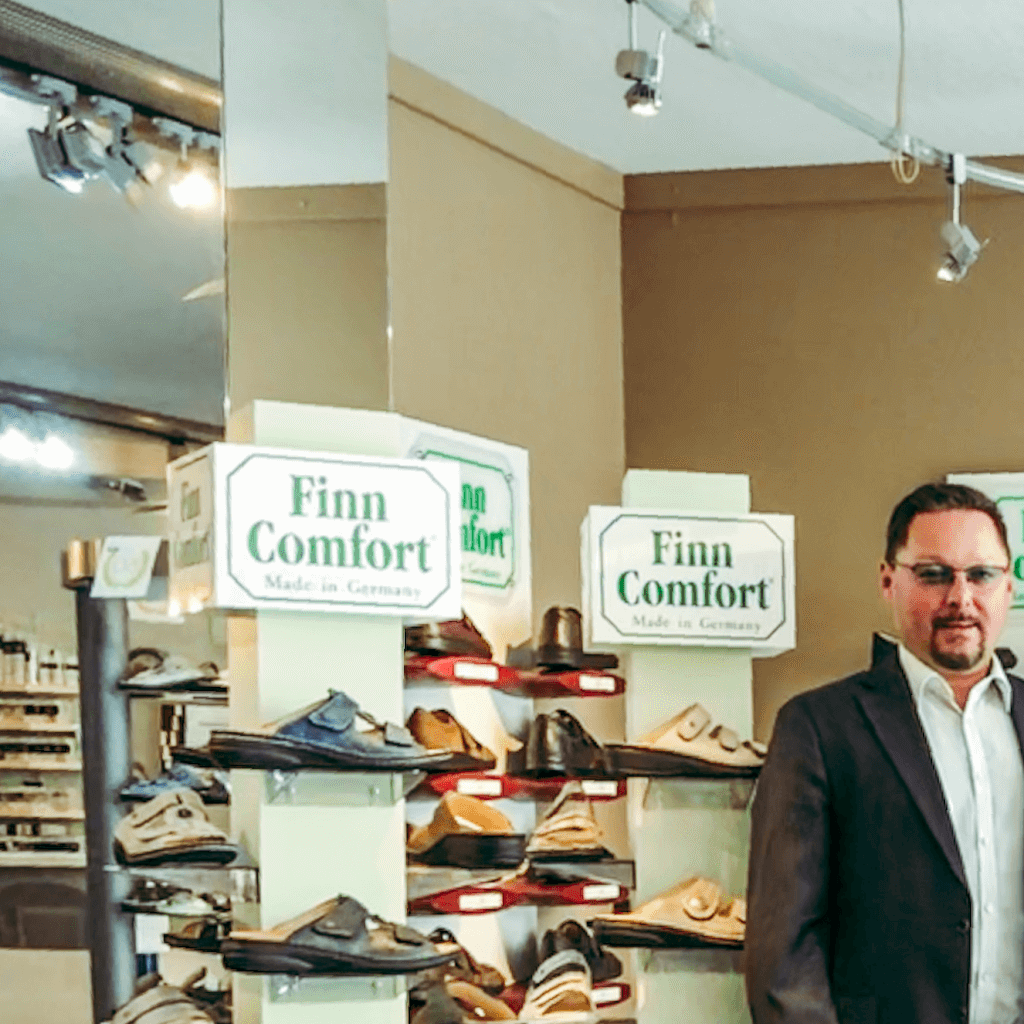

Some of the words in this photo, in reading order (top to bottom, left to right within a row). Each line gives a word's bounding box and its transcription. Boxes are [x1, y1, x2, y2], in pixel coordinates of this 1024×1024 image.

[289, 474, 389, 522] Finn
[462, 483, 486, 514] nn
[247, 520, 432, 572] Comfort
[651, 529, 734, 568] Finn
[264, 574, 311, 592] Made
[322, 578, 338, 593] in
[347, 579, 421, 600] Germany
[616, 569, 770, 610] Comfort
[631, 614, 670, 628] Made
[678, 615, 693, 629] in
[699, 616, 762, 634] Germany
